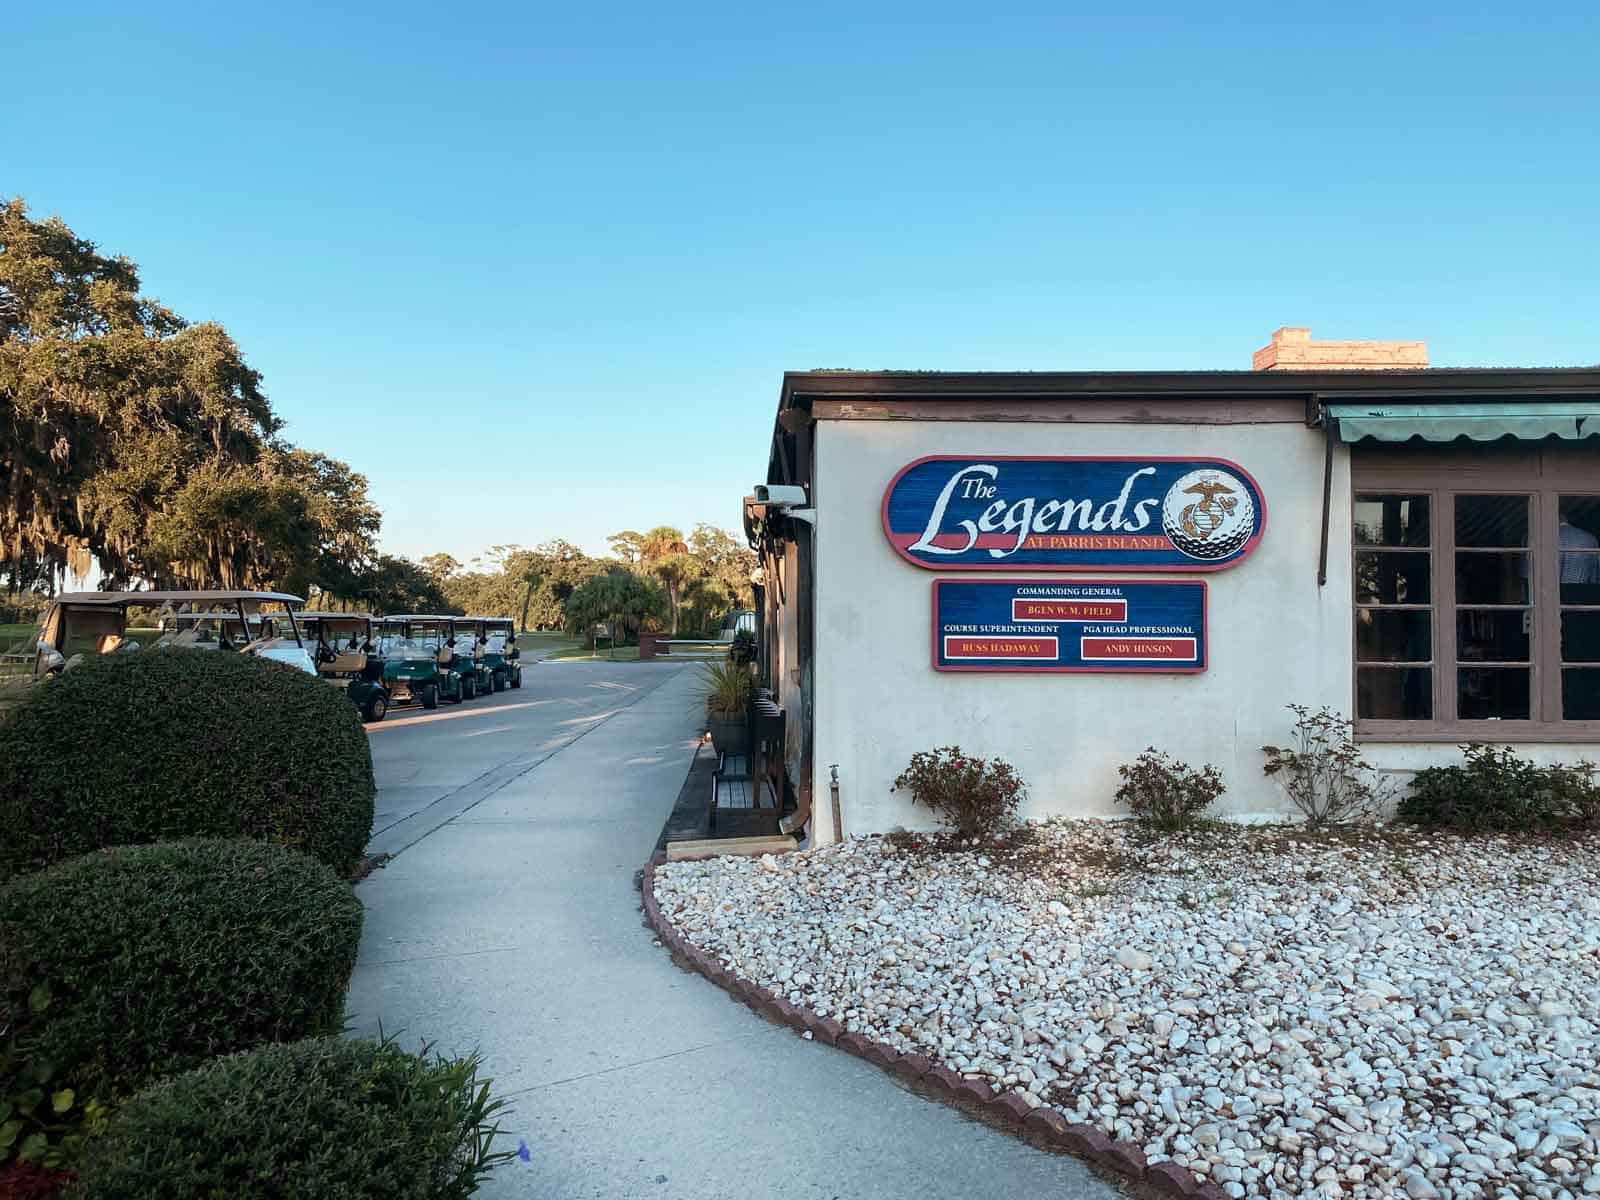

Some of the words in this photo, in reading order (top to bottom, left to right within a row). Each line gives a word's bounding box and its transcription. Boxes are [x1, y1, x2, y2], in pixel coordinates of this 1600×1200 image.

[962, 478, 998, 499] The
[907, 464, 1159, 558] Legends
[1027, 537, 1045, 549] AT
[1050, 536, 1106, 549] PARRIS
[1107, 536, 1165, 549] ISLAND
[1016, 587, 1080, 596] COMMANDING
[1081, 587, 1123, 596] GENERAL
[1027, 606, 1054, 615] BGEN
[1083, 607, 1113, 616] FIELD
[943, 624, 978, 633] COURSE
[979, 625, 1059, 633] SUPERINTENDENT
[1083, 626, 1101, 634] PGA
[1102, 626, 1128, 634] HEAD
[1129, 626, 1195, 634] PROFESSIONAL
[962, 643, 989, 652] RUSS
[990, 643, 1041, 653] HADAWAY
[1105, 644, 1132, 653] ANDY
[1134, 645, 1173, 653] HINSON
